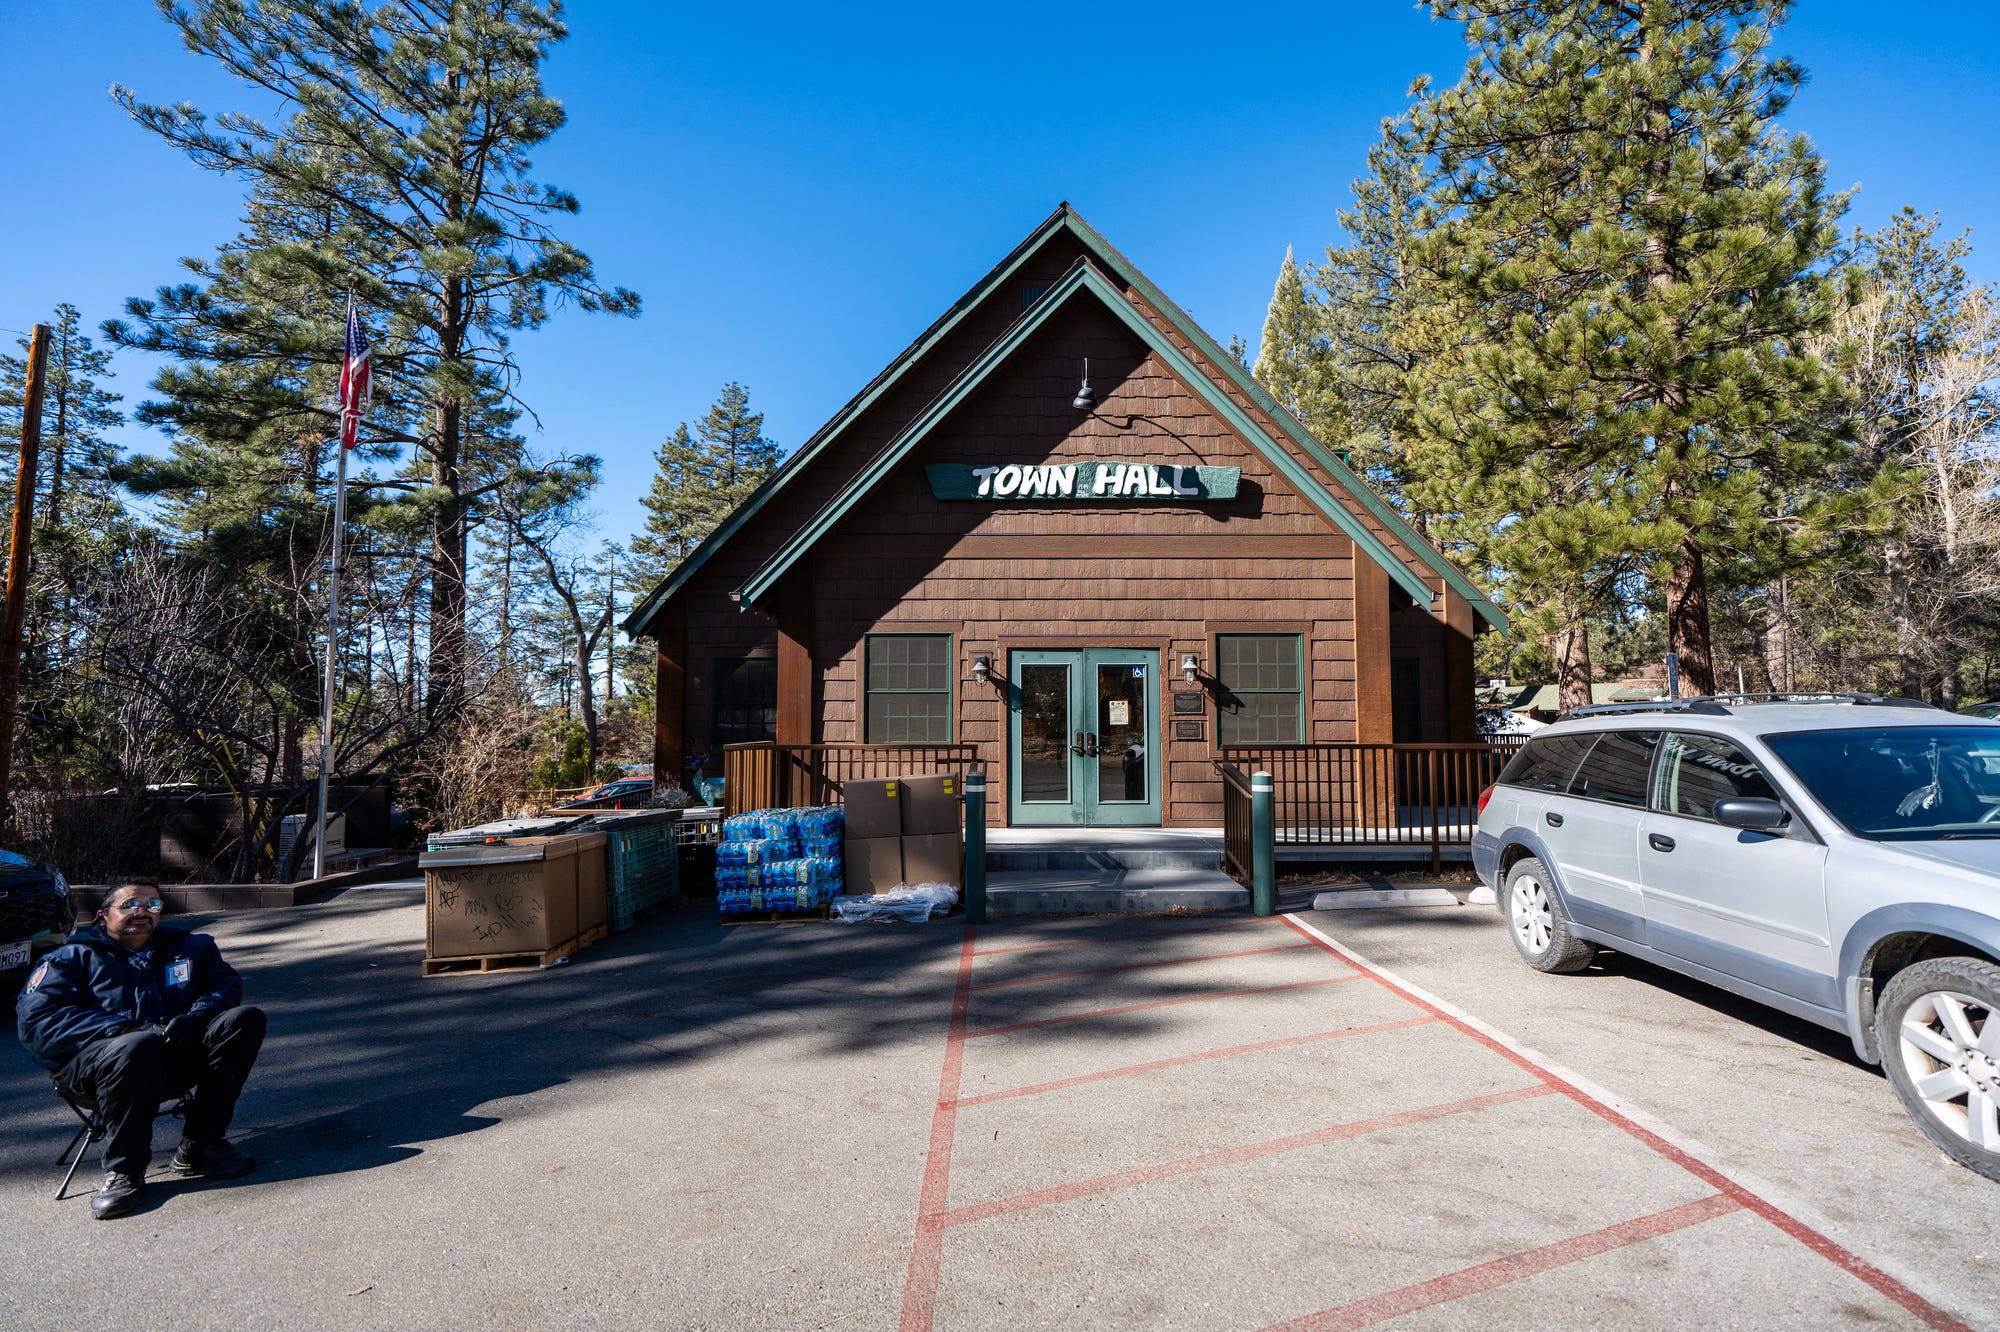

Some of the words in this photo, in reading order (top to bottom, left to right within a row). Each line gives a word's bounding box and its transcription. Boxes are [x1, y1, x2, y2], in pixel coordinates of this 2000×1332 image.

[972, 465, 1077, 496] TOWN
[1092, 464, 1198, 495] HALL
[0, 950, 27, 966] M097
